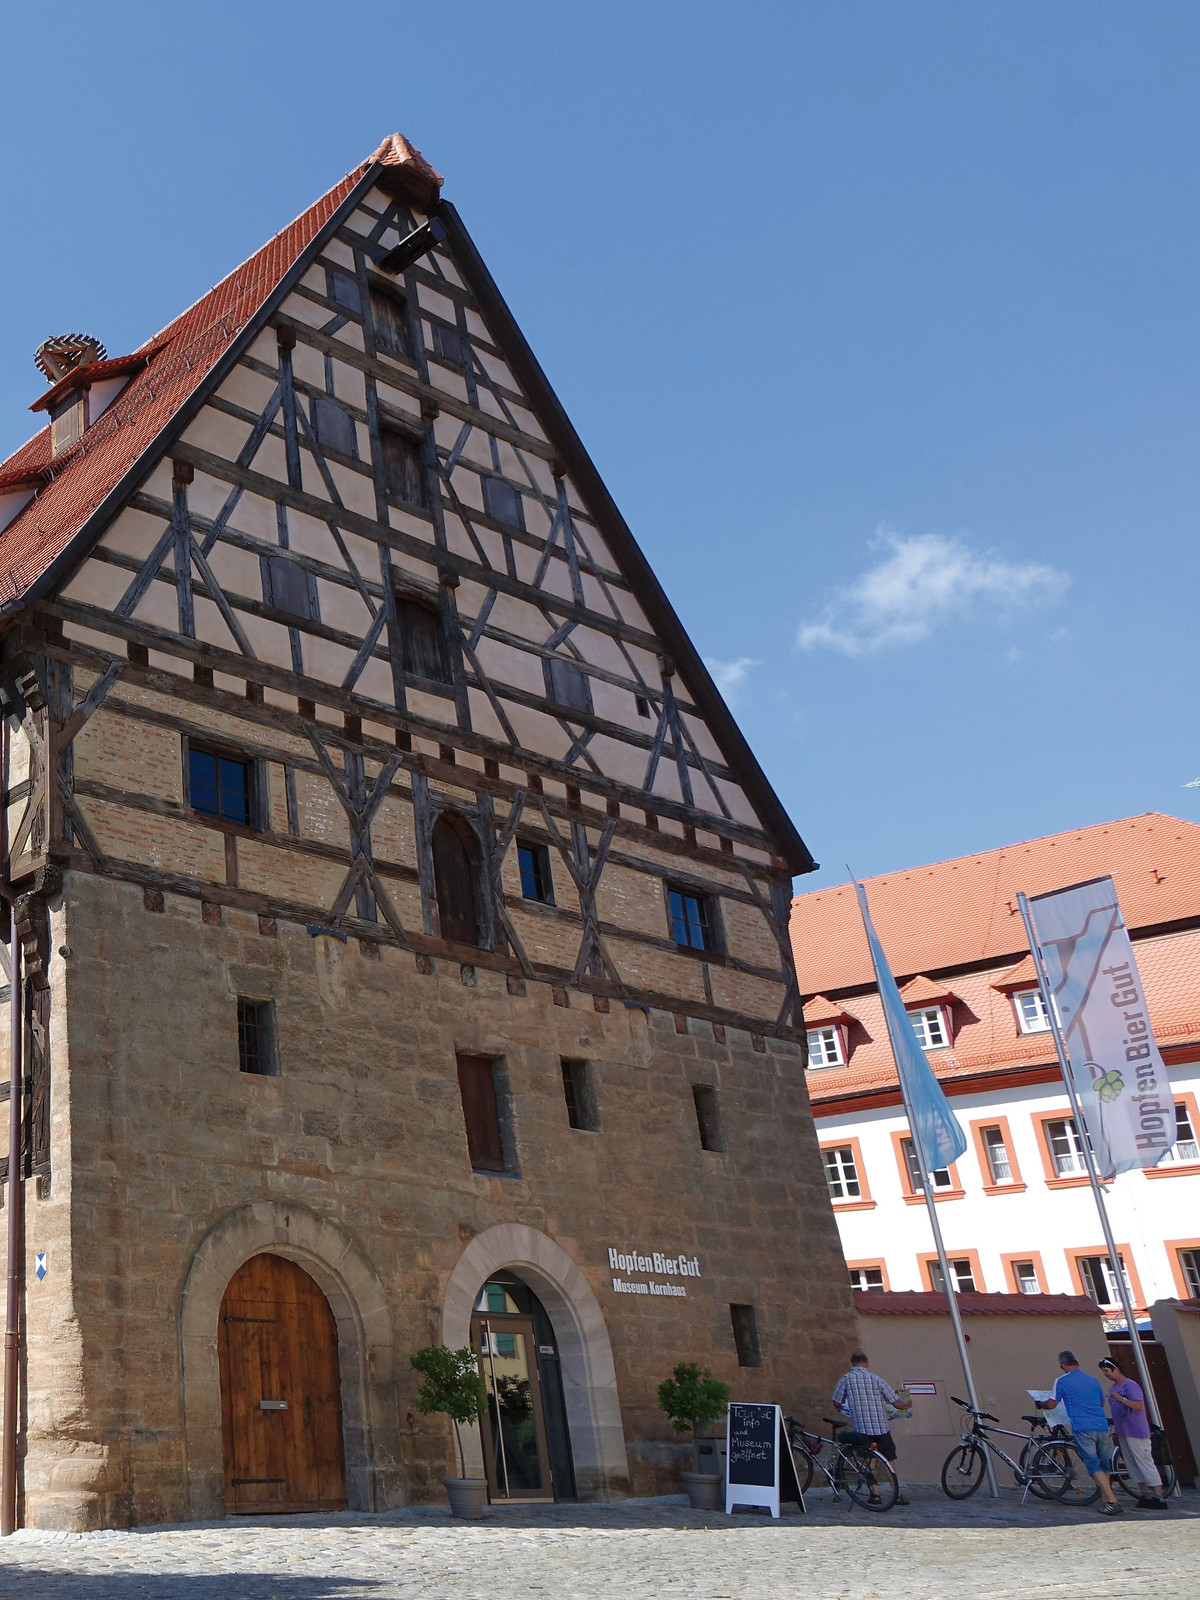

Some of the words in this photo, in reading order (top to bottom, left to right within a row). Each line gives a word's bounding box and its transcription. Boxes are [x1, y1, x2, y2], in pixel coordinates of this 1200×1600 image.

[1103, 961, 1139, 1008] Gut
[1123, 1011, 1151, 1062] Bier
[1131, 1063, 1169, 1149] Hopfen
[612, 1278, 648, 1295] Museum
[649, 1281, 686, 1297] Kornhaus
[731, 1437, 771, 1448] Museum
